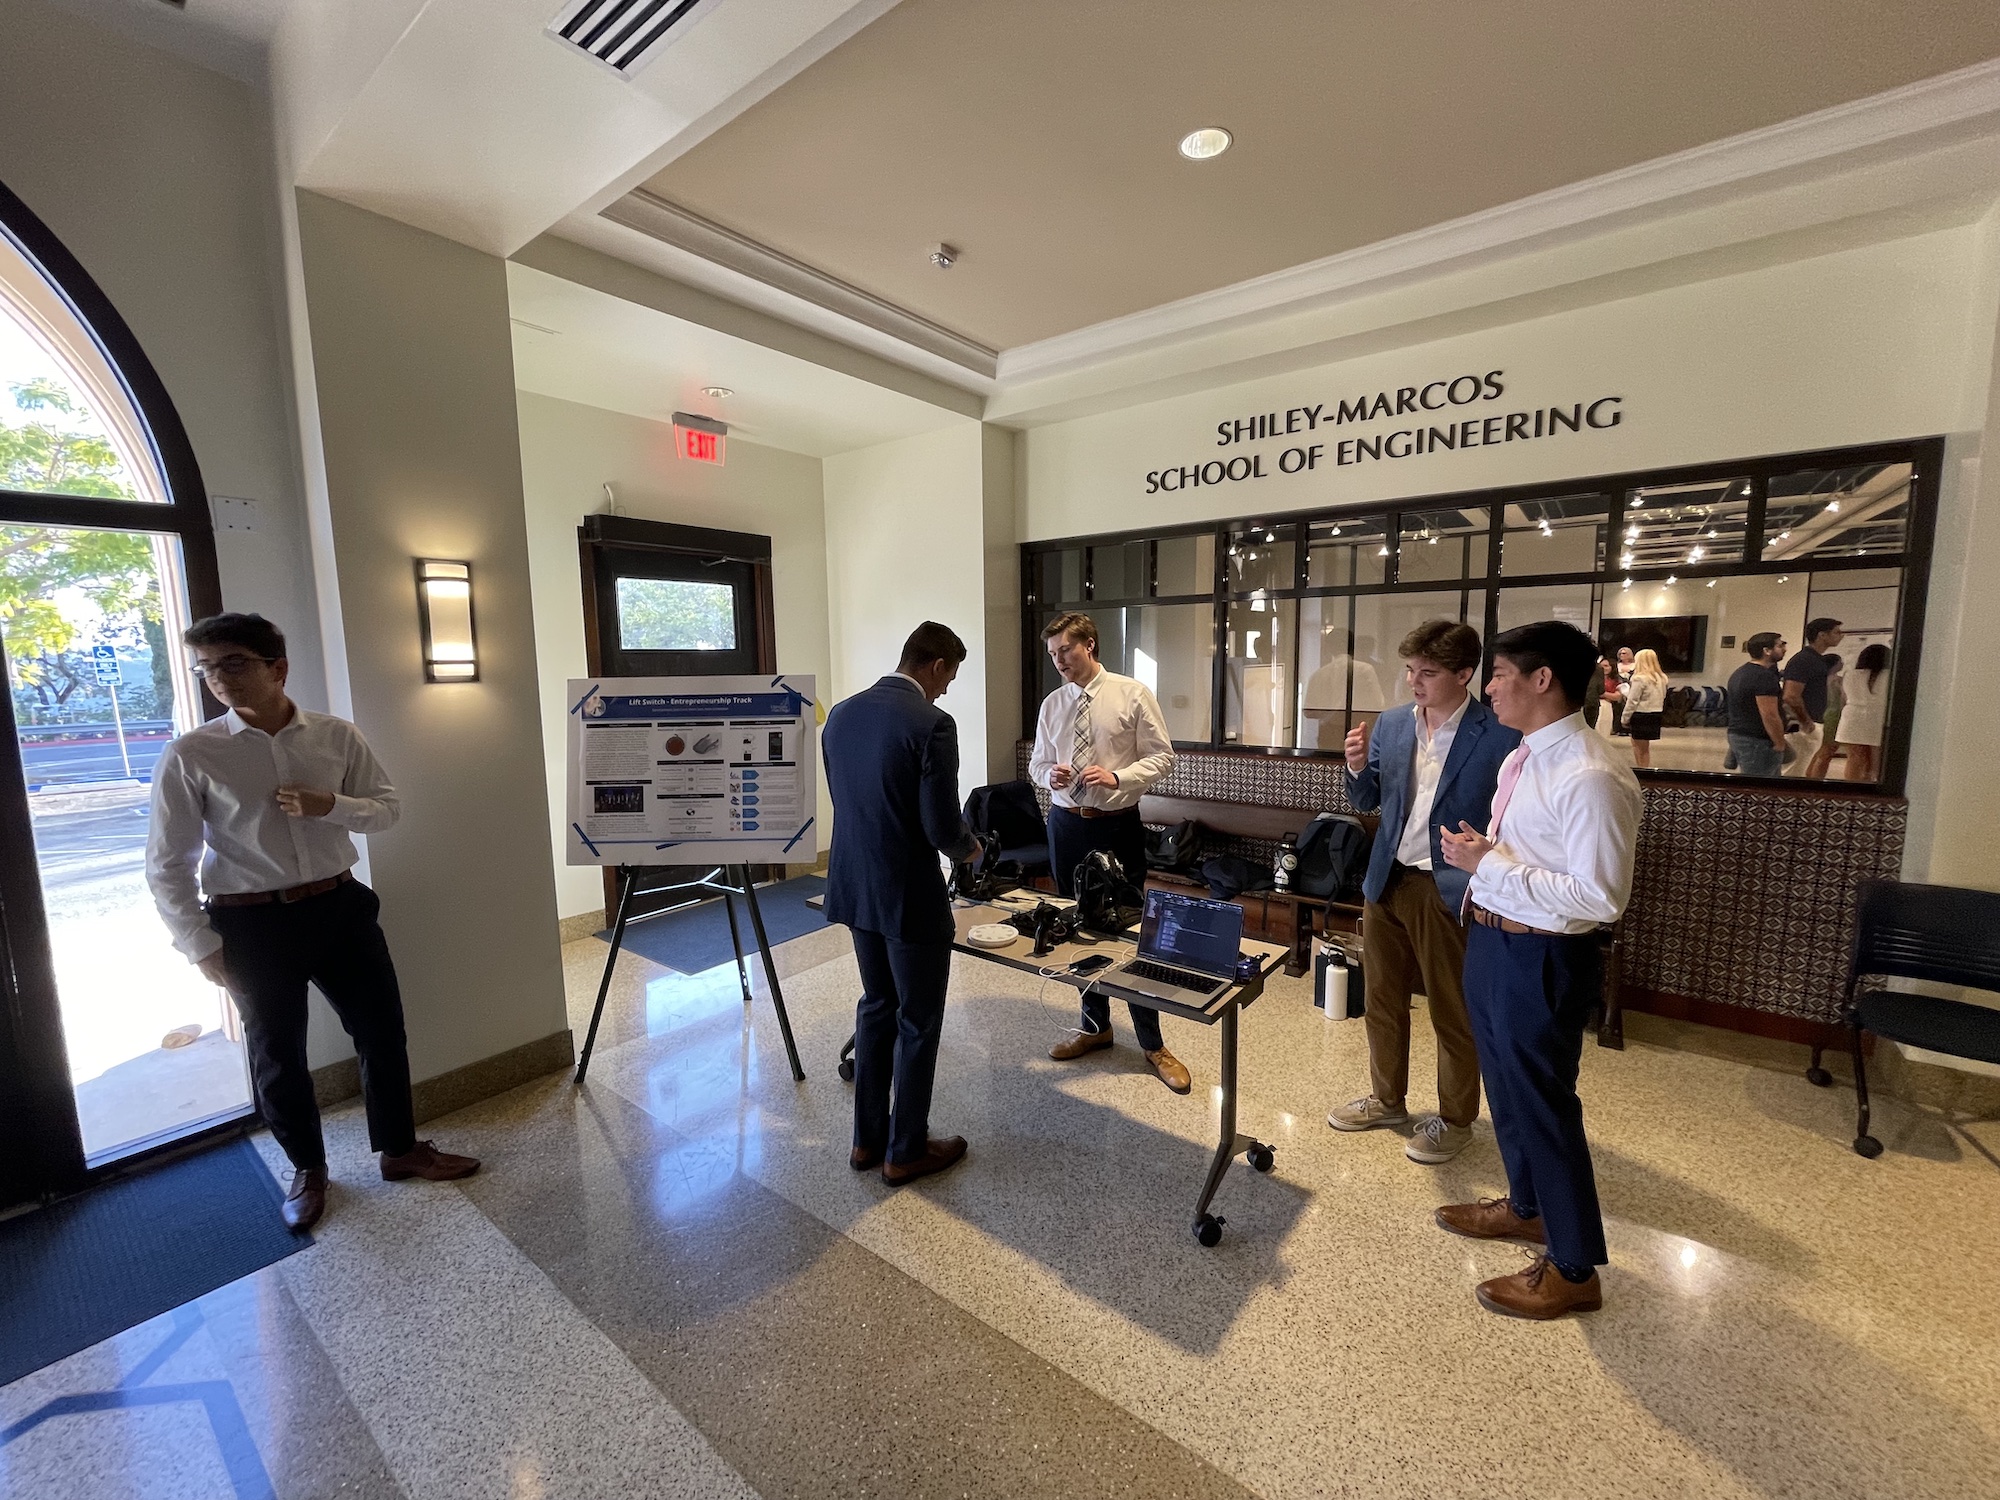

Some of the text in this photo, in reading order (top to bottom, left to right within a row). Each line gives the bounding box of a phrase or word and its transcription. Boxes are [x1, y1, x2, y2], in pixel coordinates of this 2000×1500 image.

[1217, 371, 1505, 446] SHILEY-MARCOS
[687, 430, 717, 461] EXIT
[1145, 398, 1623, 494] SCHOOL OF ENGINEERING
[629, 698, 641, 706] Lift
[670, 697, 731, 706] Entrepreneurship
